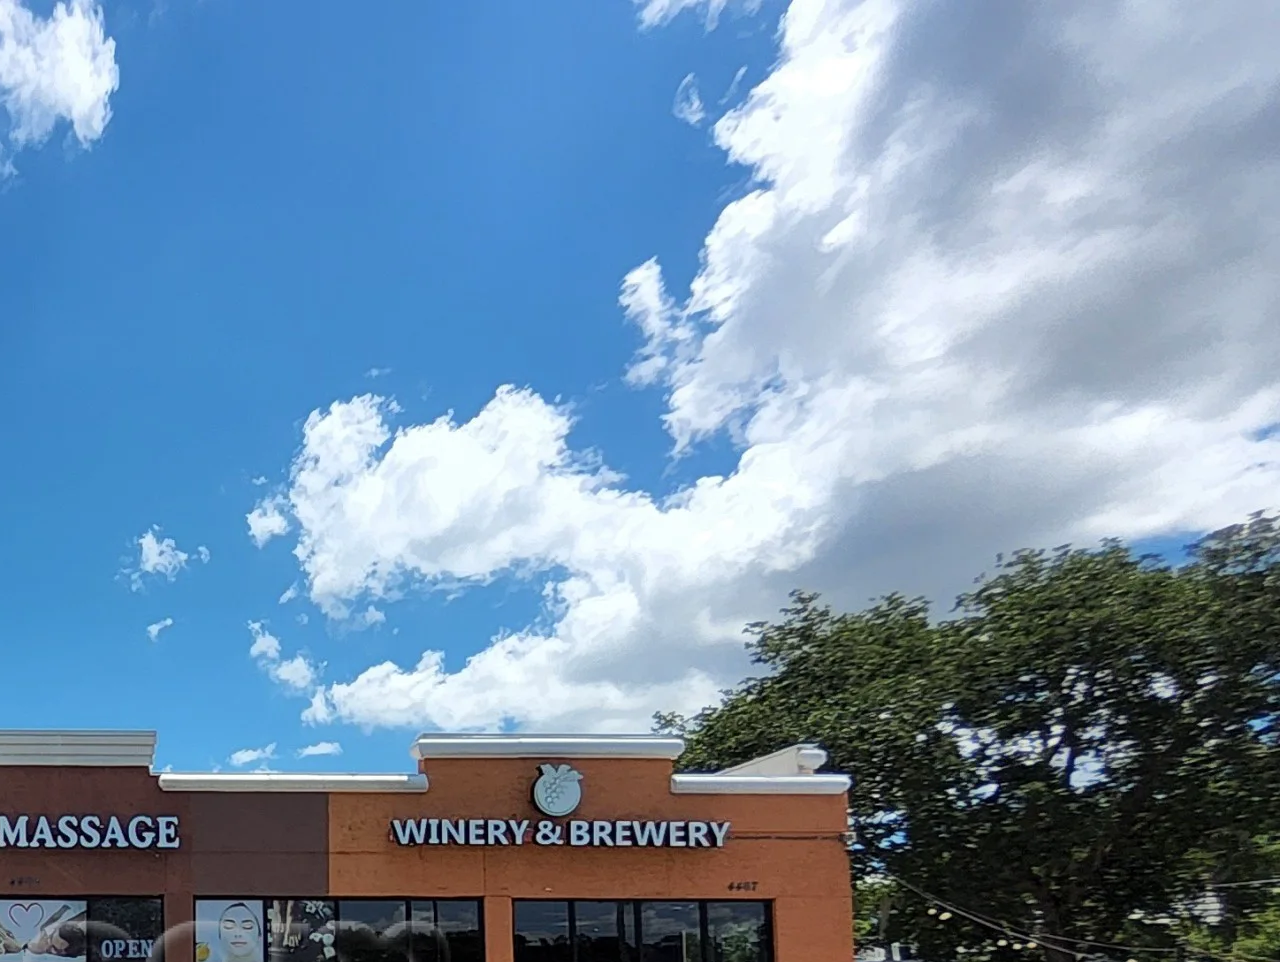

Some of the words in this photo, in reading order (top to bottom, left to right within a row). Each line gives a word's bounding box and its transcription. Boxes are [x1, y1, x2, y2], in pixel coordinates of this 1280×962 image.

[391, 818, 530, 846] WINERY
[535, 820, 565, 845] &
[570, 821, 732, 848] BREWERY
[101, 939, 153, 959] OPEN
